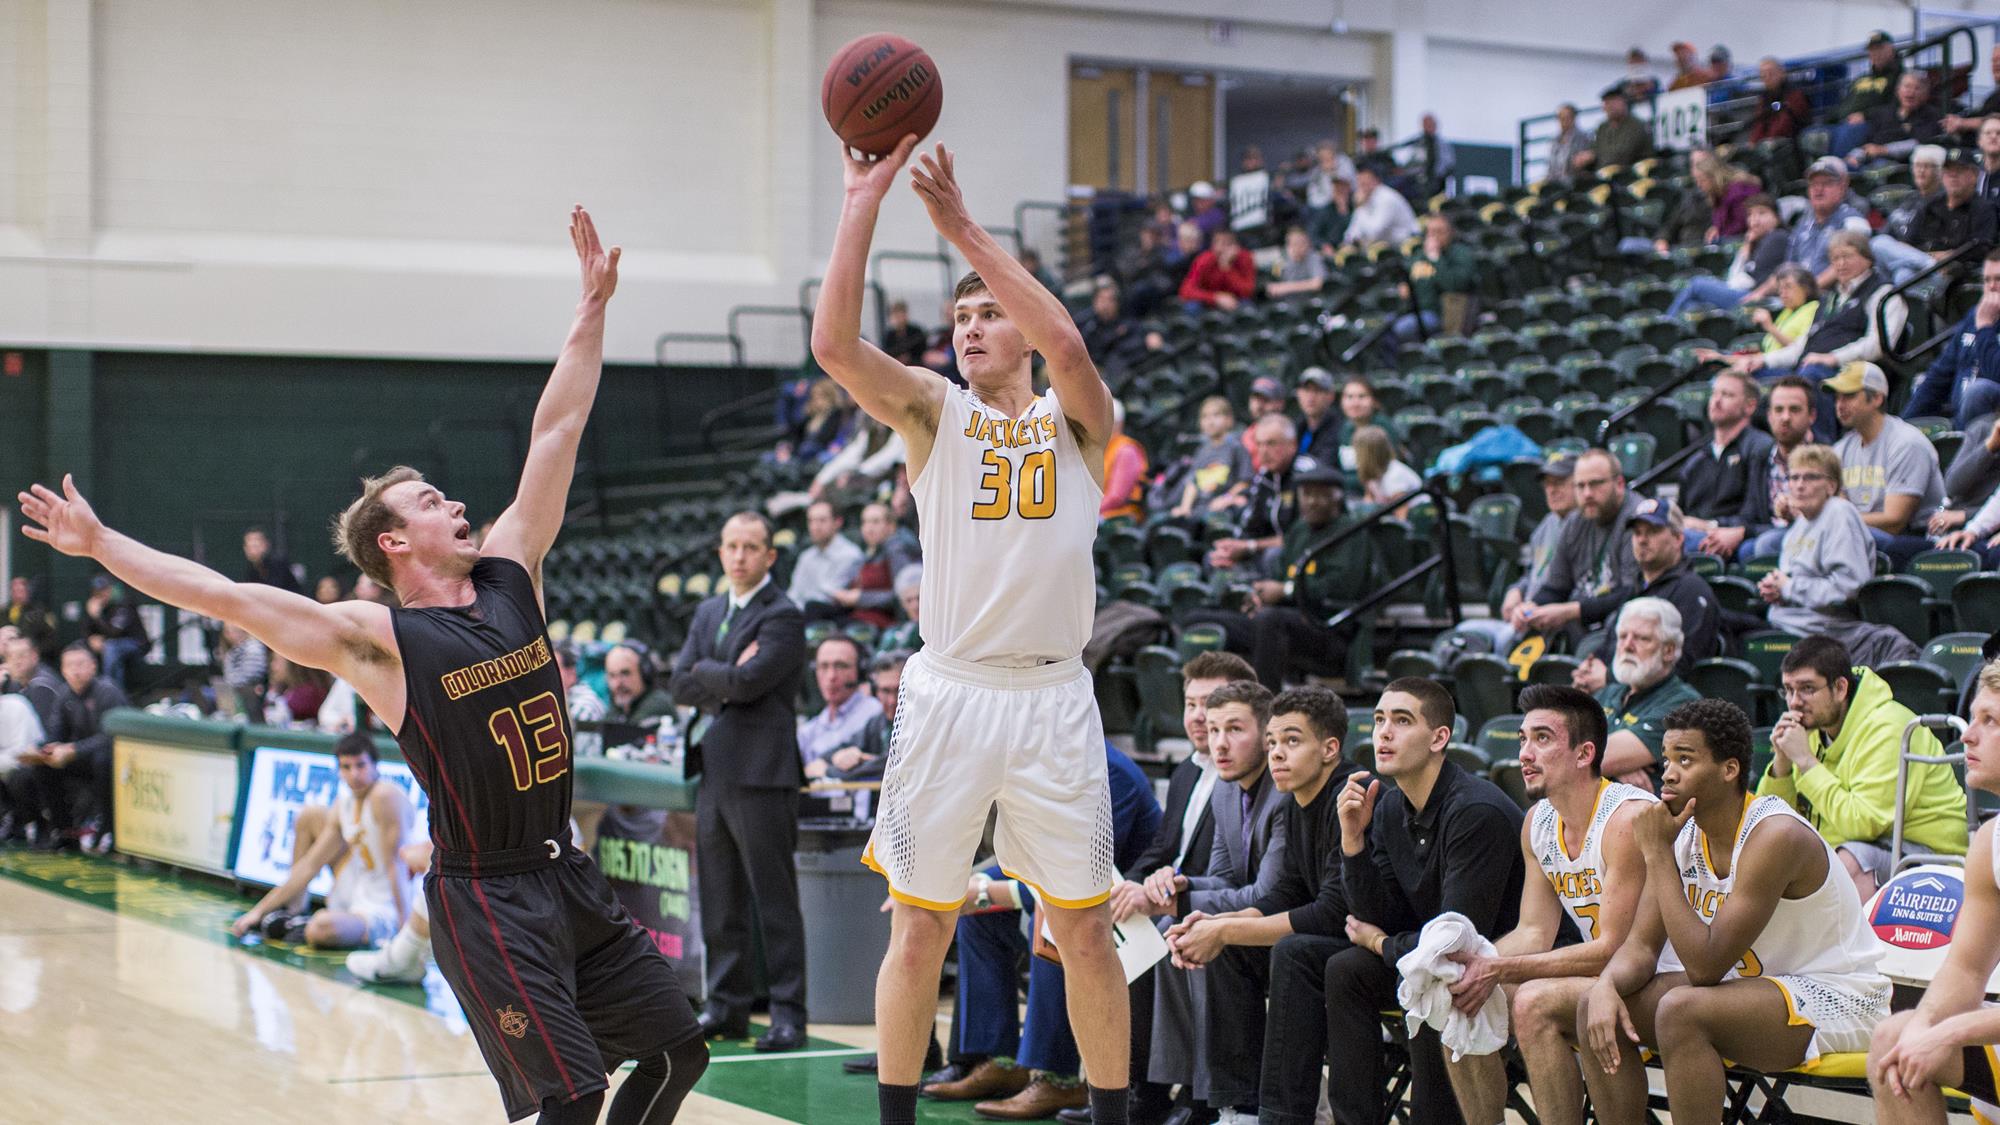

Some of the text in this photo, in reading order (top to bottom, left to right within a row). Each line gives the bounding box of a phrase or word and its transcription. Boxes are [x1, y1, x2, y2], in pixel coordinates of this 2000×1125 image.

[846, 42, 896, 87] NCAA
[863, 62, 929, 120] Wilson
[964, 410, 1057, 449] JACKETS
[972, 448, 1056, 520] 30
[441, 649, 530, 700] COLORADO
[488, 691, 568, 791] 13
[1888, 886, 1957, 913] FAIRFIELD
[1890, 927, 1933, 945] Marriott
